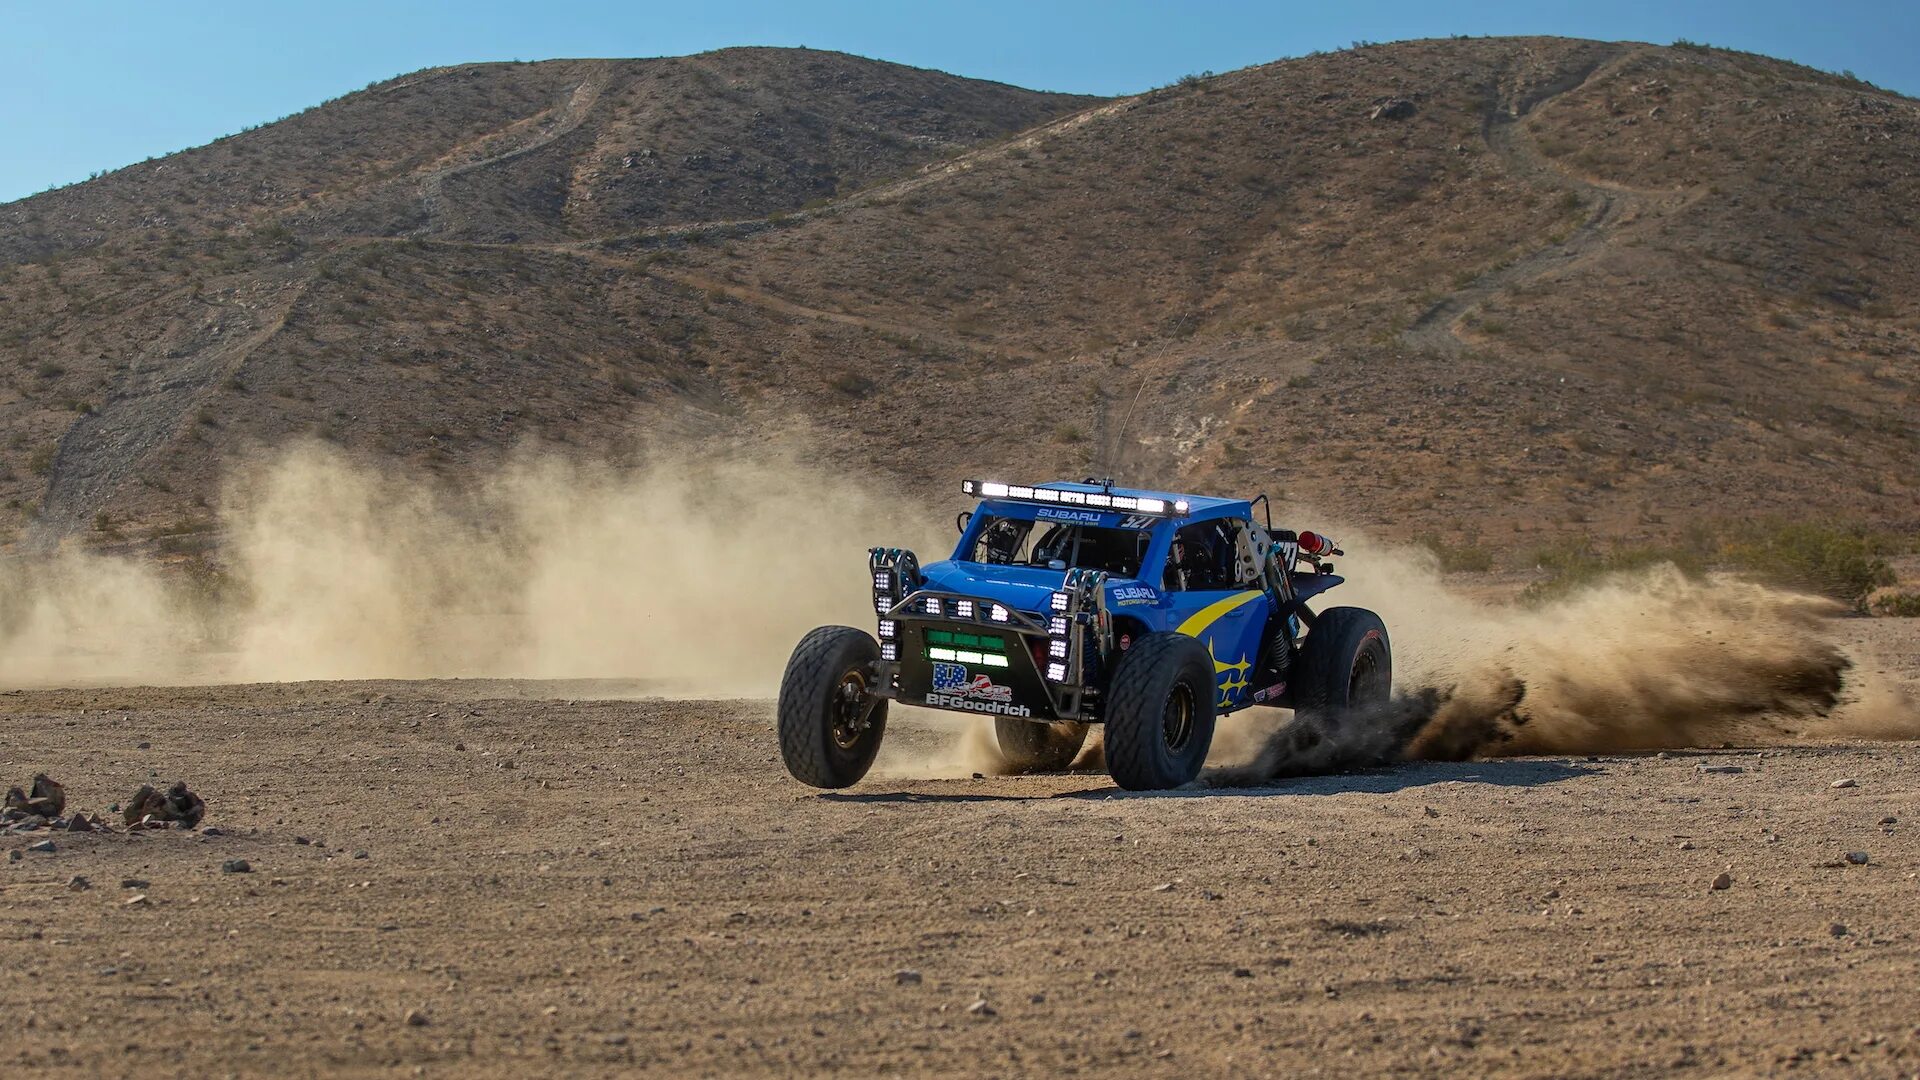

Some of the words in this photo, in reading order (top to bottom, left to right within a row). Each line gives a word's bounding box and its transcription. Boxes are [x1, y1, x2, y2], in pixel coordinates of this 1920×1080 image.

[1037, 508, 1101, 522] SUBARU
[1113, 588, 1156, 600] SUBARU
[926, 692, 1031, 717] BFGoodrich
